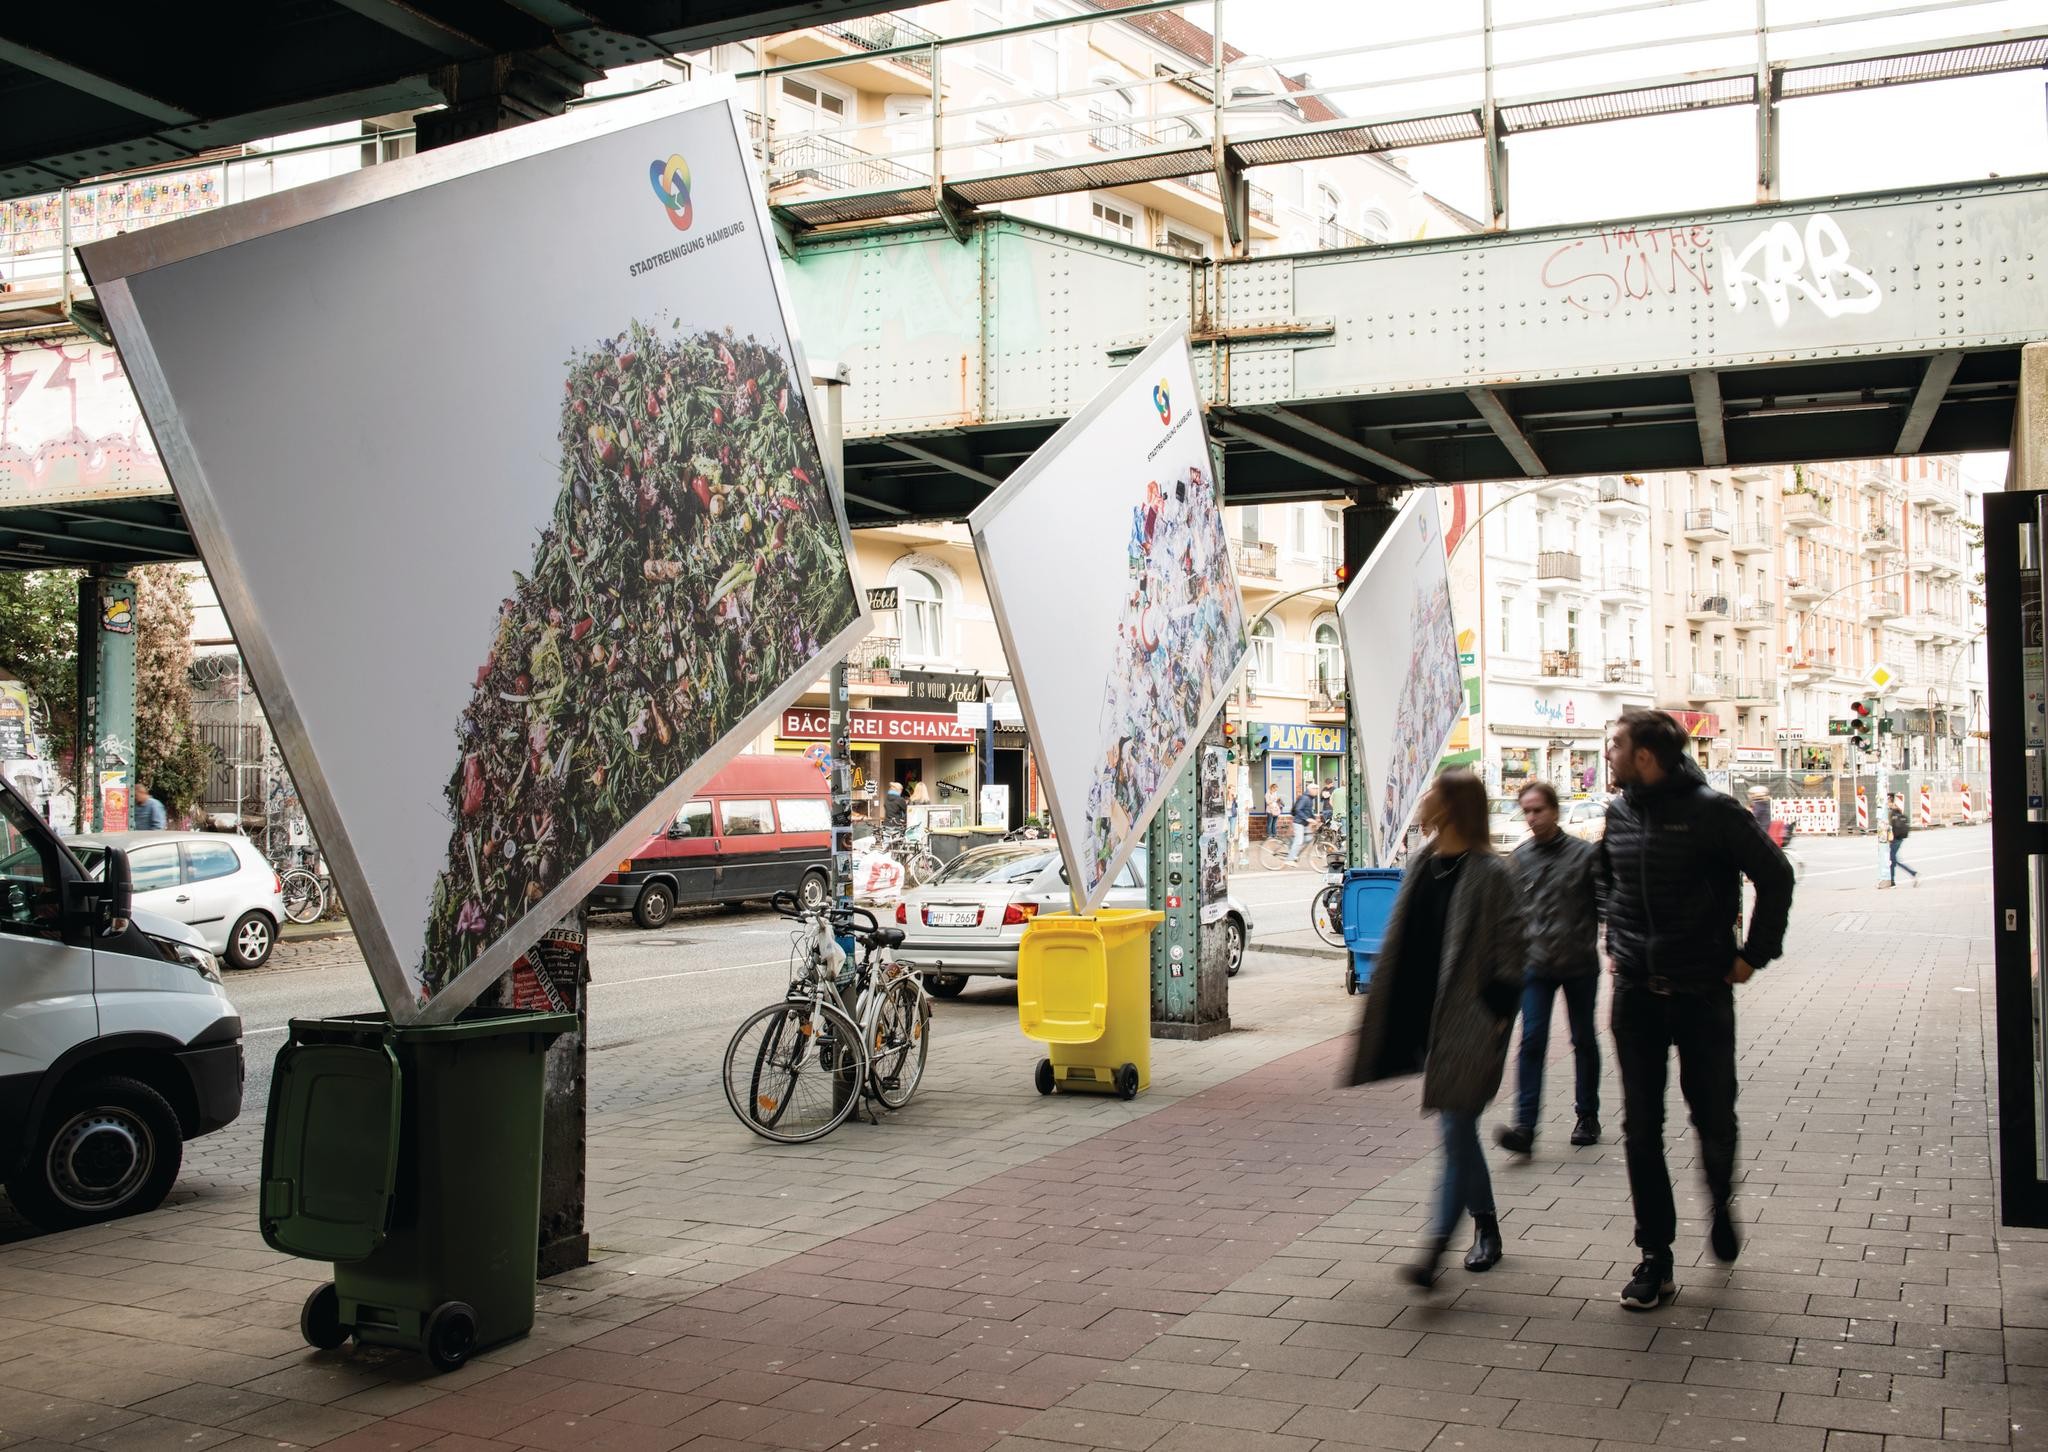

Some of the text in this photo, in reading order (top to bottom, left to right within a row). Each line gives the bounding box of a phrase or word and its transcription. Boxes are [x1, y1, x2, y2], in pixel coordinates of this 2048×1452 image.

[629, 221, 745, 277] STADTREINIGUNG HAMBURG
[867, 590, 897, 609] Hotel
[917, 682, 925, 698] IS
[927, 682, 947, 699] YOUR
[948, 682, 978, 703] Hotel
[787, 713, 883, 735] BÄCREI
[889, 719, 971, 737] SCHANZE
[1269, 725, 1341, 751] PLAYTECH
[934, 914, 944, 923] HH
[955, 913, 976, 923] 2667
